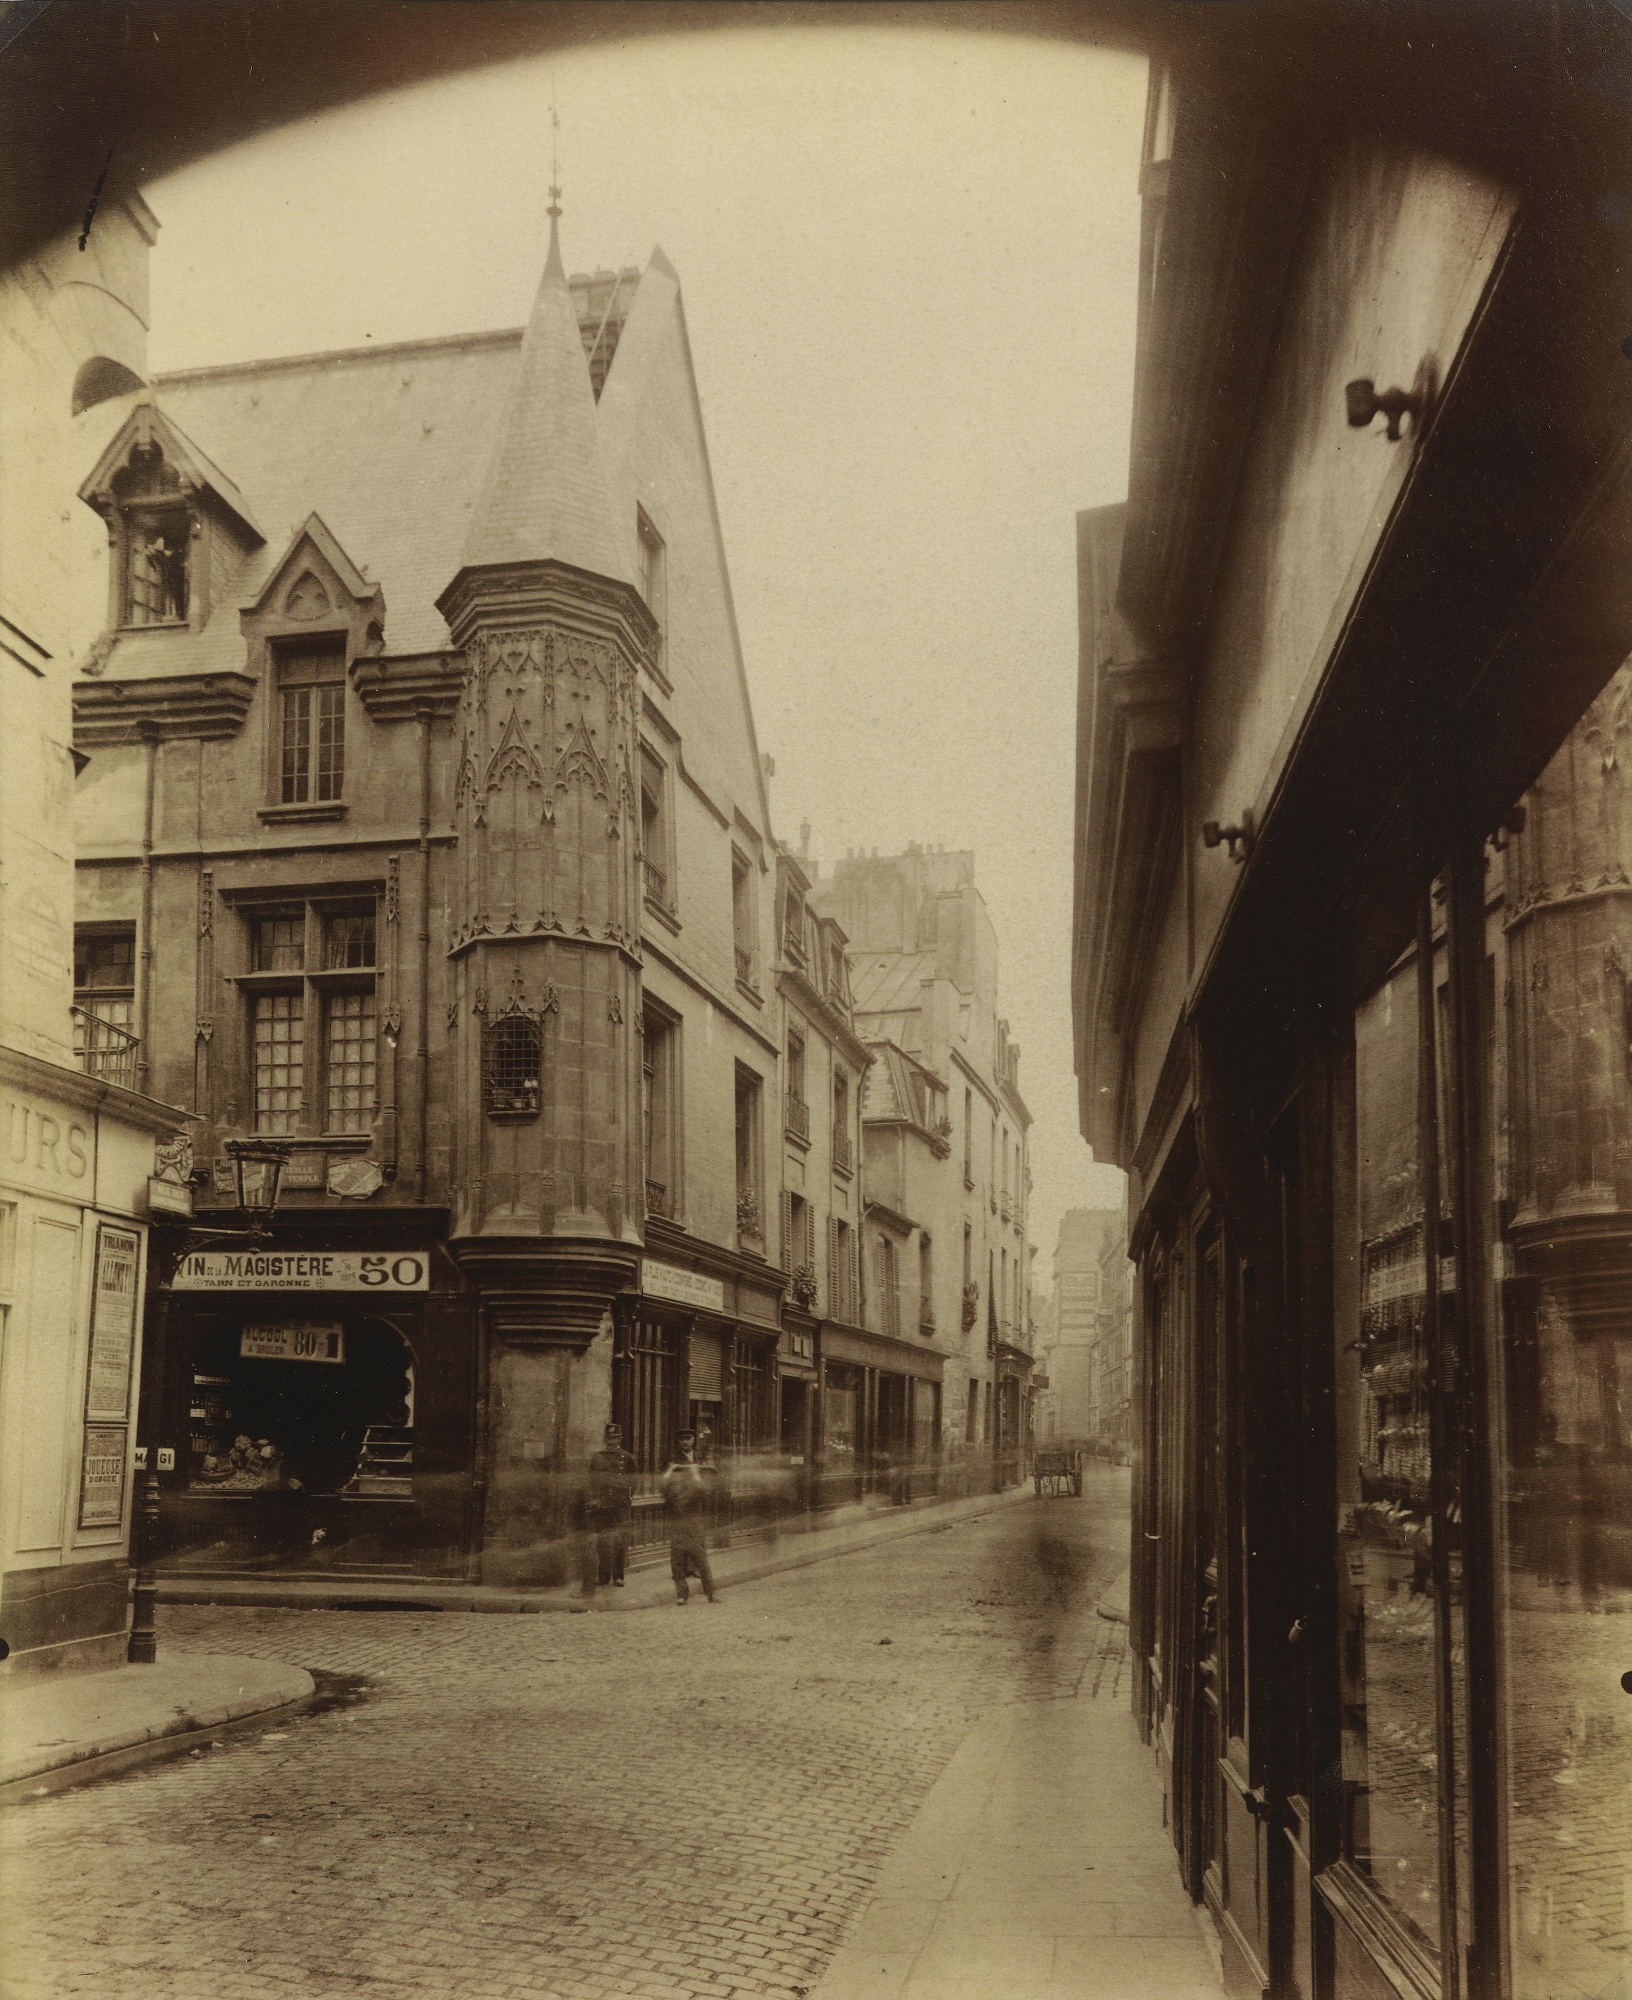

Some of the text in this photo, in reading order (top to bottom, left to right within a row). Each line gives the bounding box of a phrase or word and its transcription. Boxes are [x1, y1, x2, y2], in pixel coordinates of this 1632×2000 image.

[288, 1174, 319, 1182] TEMPLE
[103, 1234, 135, 1253] TRIANON
[358, 1256, 424, 1286] 50
[245, 1327, 288, 1343] ALCOOL
[294, 1331, 317, 1356] 80
[134, 1453, 171, 1464] MGI
[86, 1459, 121, 1476] JOUEUSE
